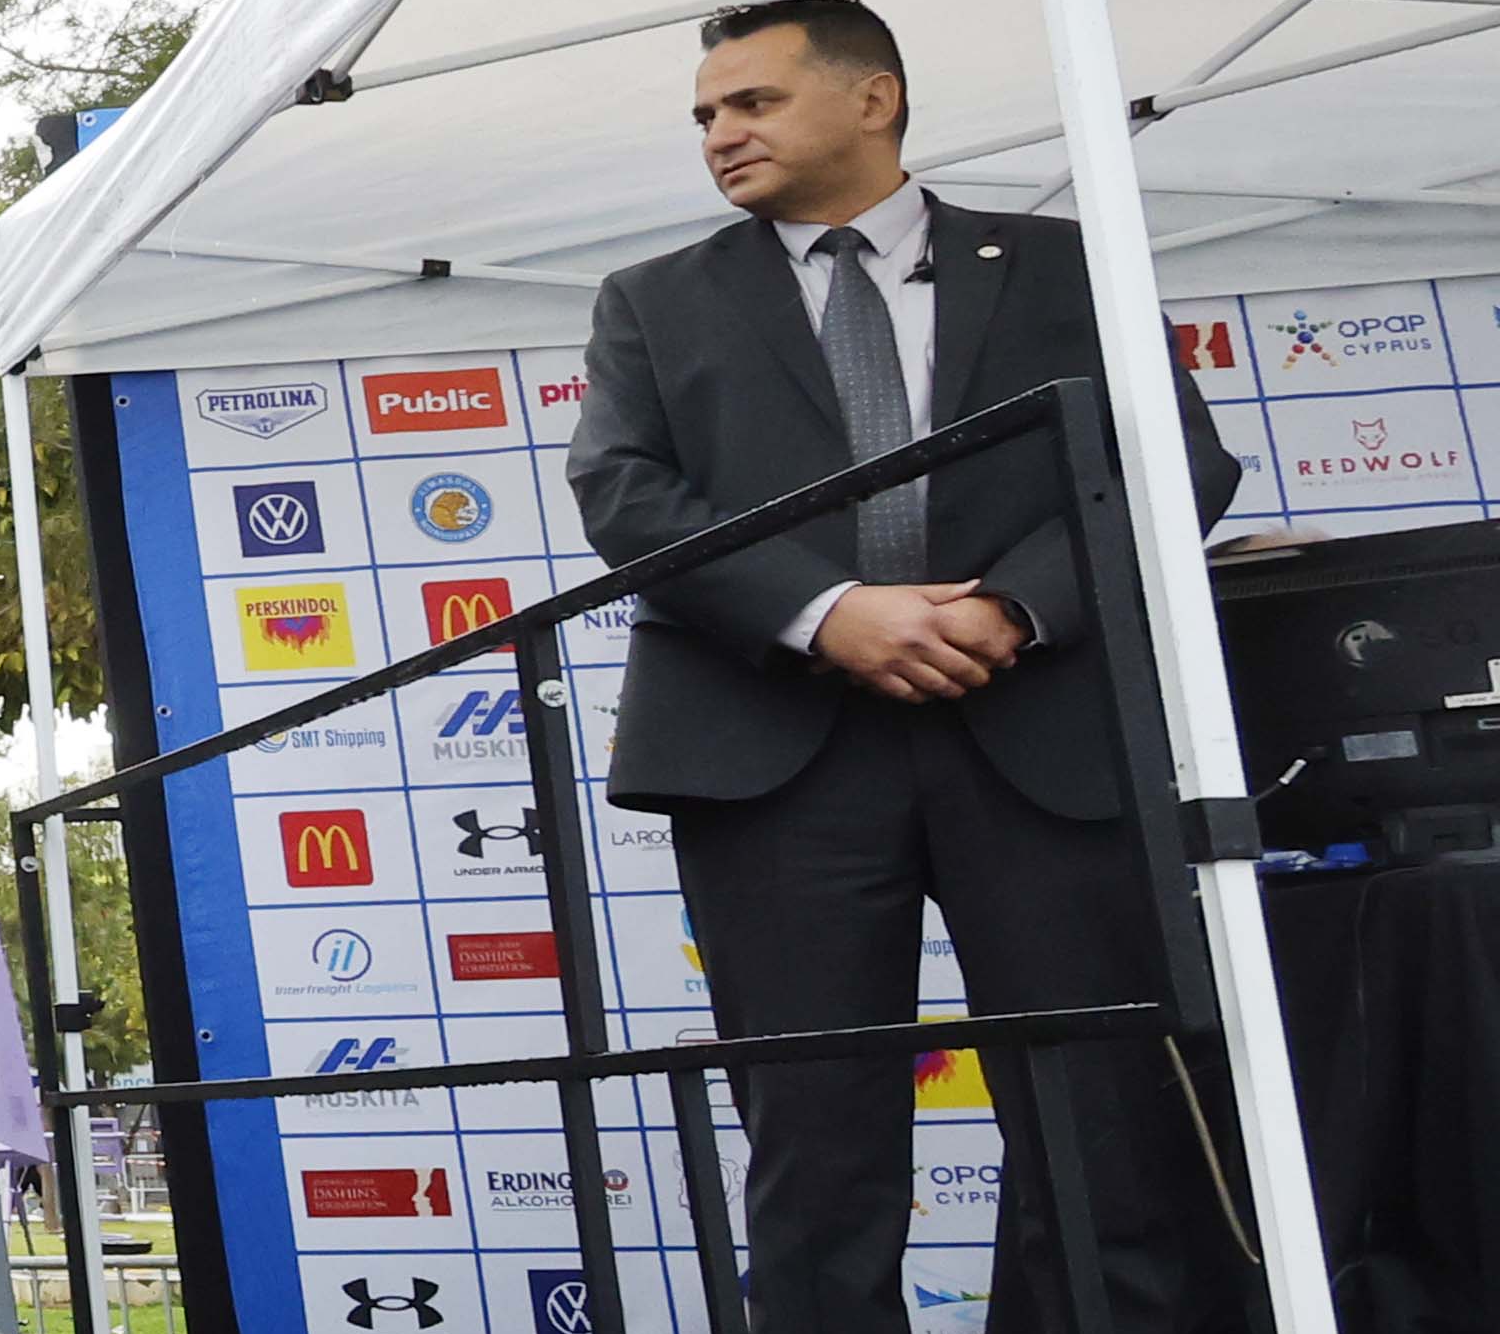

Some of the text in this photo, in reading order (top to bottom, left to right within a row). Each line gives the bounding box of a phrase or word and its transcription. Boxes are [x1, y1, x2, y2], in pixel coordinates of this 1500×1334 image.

[1344, 338, 1432, 356] CYPRUS
[208, 388, 317, 412] PETROLINA
[378, 387, 492, 416] Public
[245, 597, 338, 617] PERSKINDOL
[292, 728, 387, 752] SMT Shipping
[433, 739, 528, 760] MUSKIT
[453, 864, 546, 876] UNDER ARMO
[486, 1170, 572, 1192] ERDING
[936, 1190, 998, 1205] CYPR
